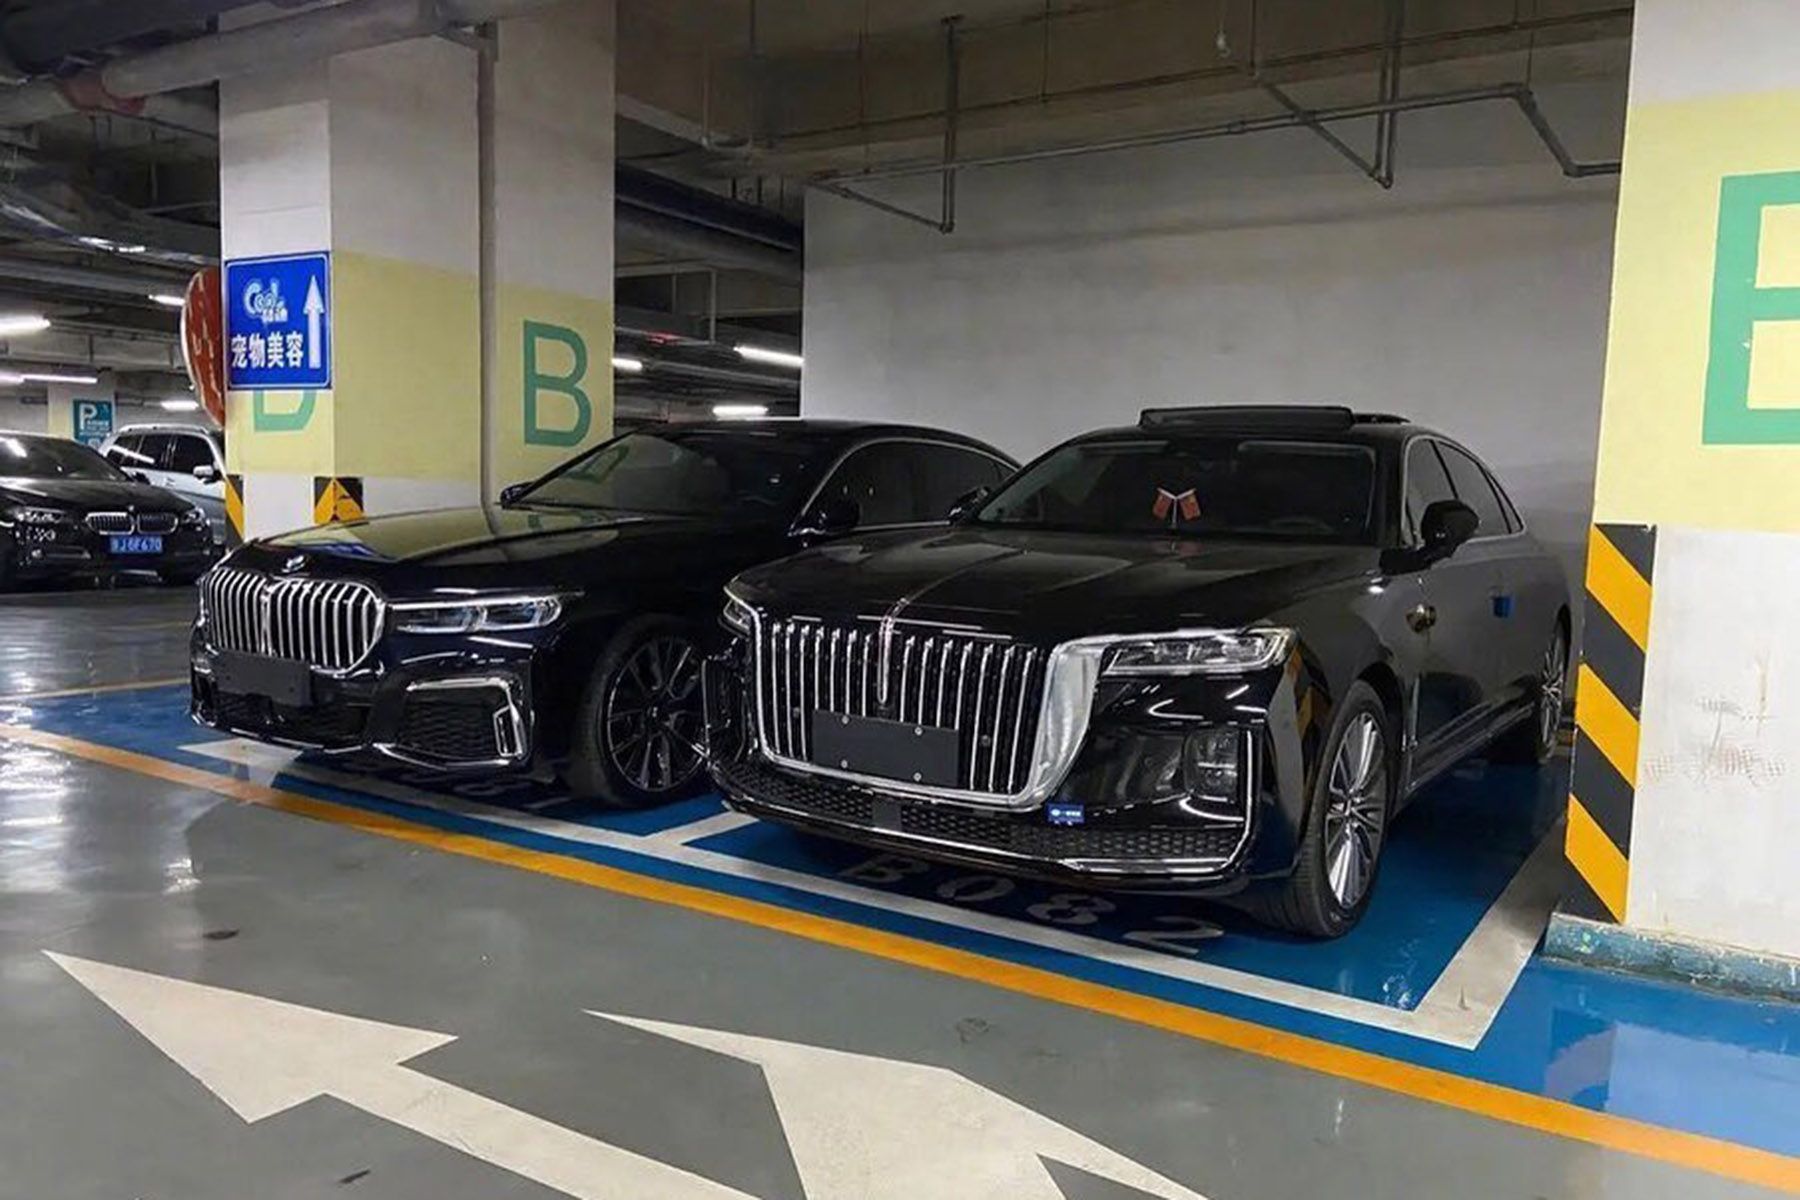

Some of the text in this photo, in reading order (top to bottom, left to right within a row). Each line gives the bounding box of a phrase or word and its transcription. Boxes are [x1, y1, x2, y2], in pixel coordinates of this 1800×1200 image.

[231, 331, 304, 368] 宠物美容
[524, 320, 592, 447] B
[79, 403, 98, 430] P
[837, 853, 1225, 954] B082
